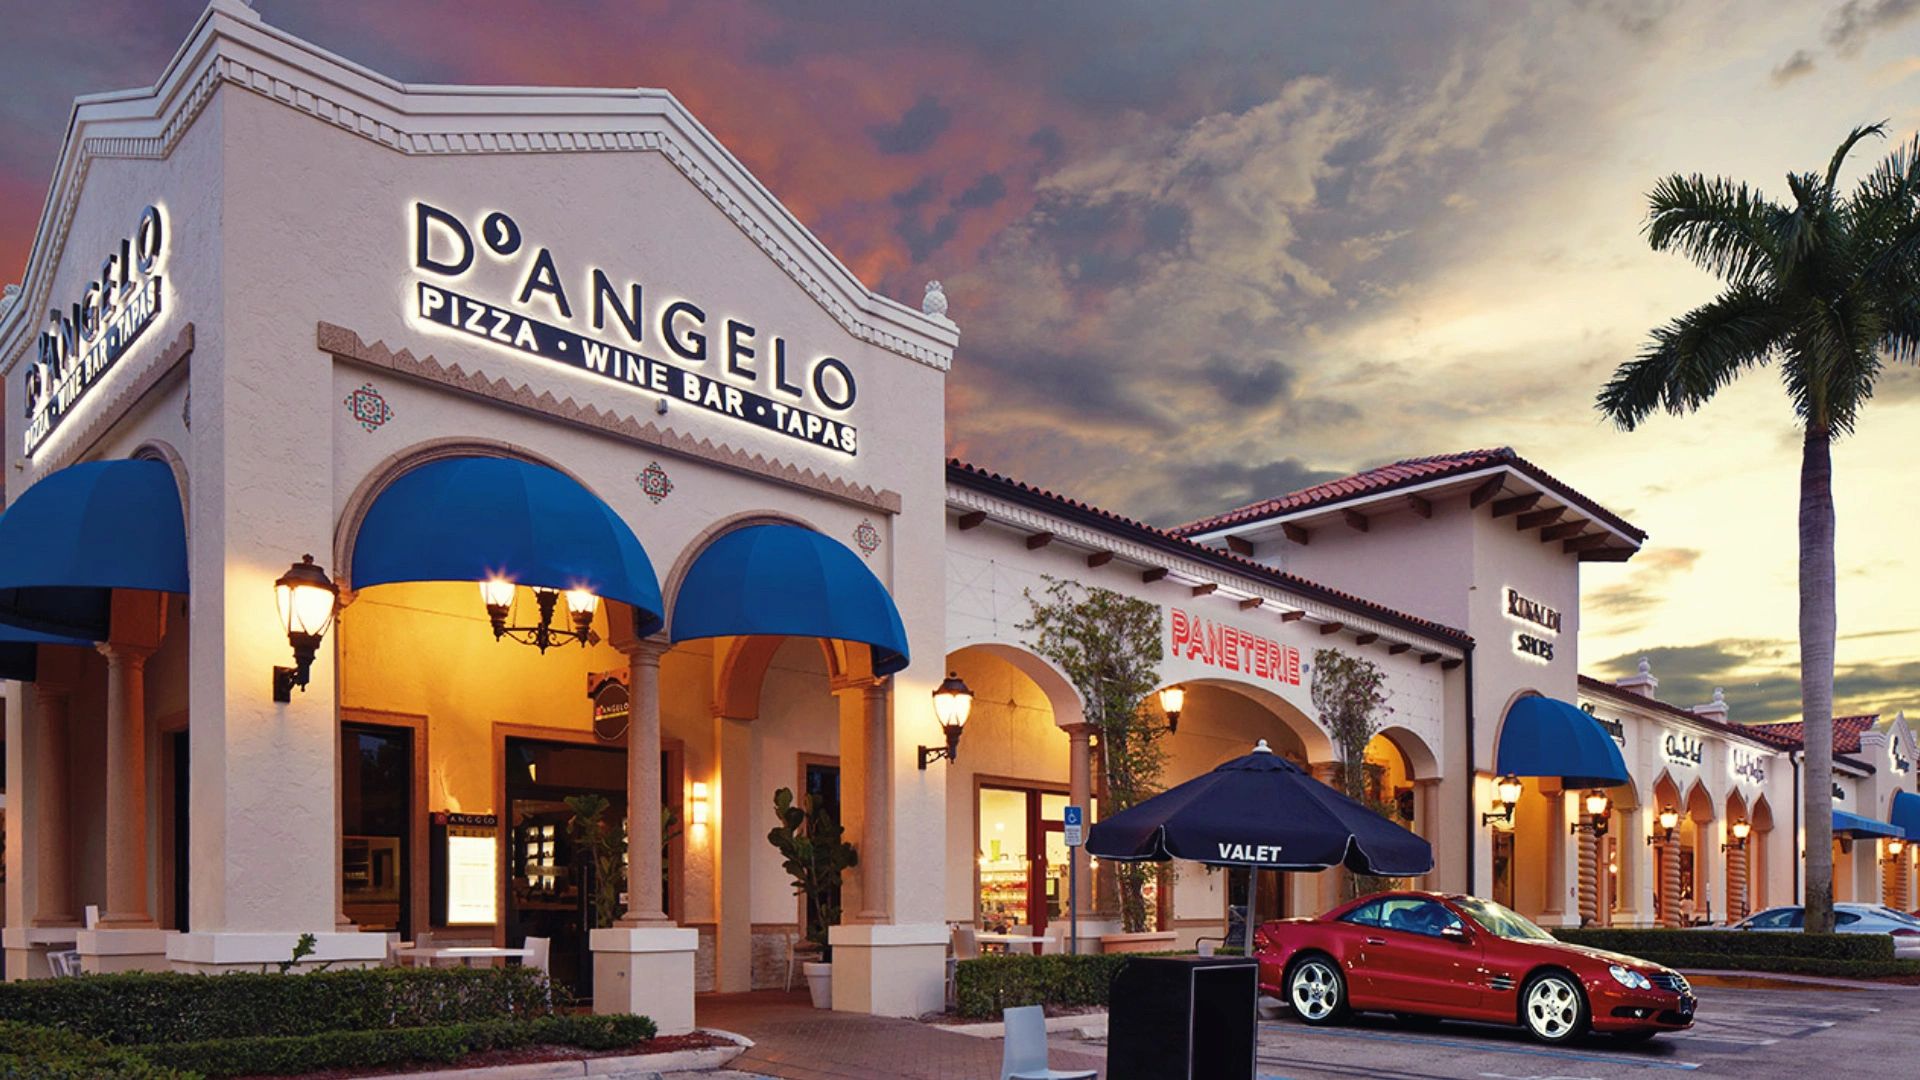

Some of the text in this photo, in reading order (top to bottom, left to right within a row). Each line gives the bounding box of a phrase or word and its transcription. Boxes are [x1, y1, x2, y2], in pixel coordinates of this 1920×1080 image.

[84, 336, 108, 385] BAR
[116, 279, 156, 349] TAPAS
[416, 201, 857, 412] D'ANGELO
[421, 285, 857, 454] PIZZA WINE BAR TAPAS
[1171, 607, 1300, 686] PANETERIE
[1507, 587, 1562, 634] RINALDI
[1517, 633, 1554, 661] SHOES
[1218, 842, 1282, 863] VALET
